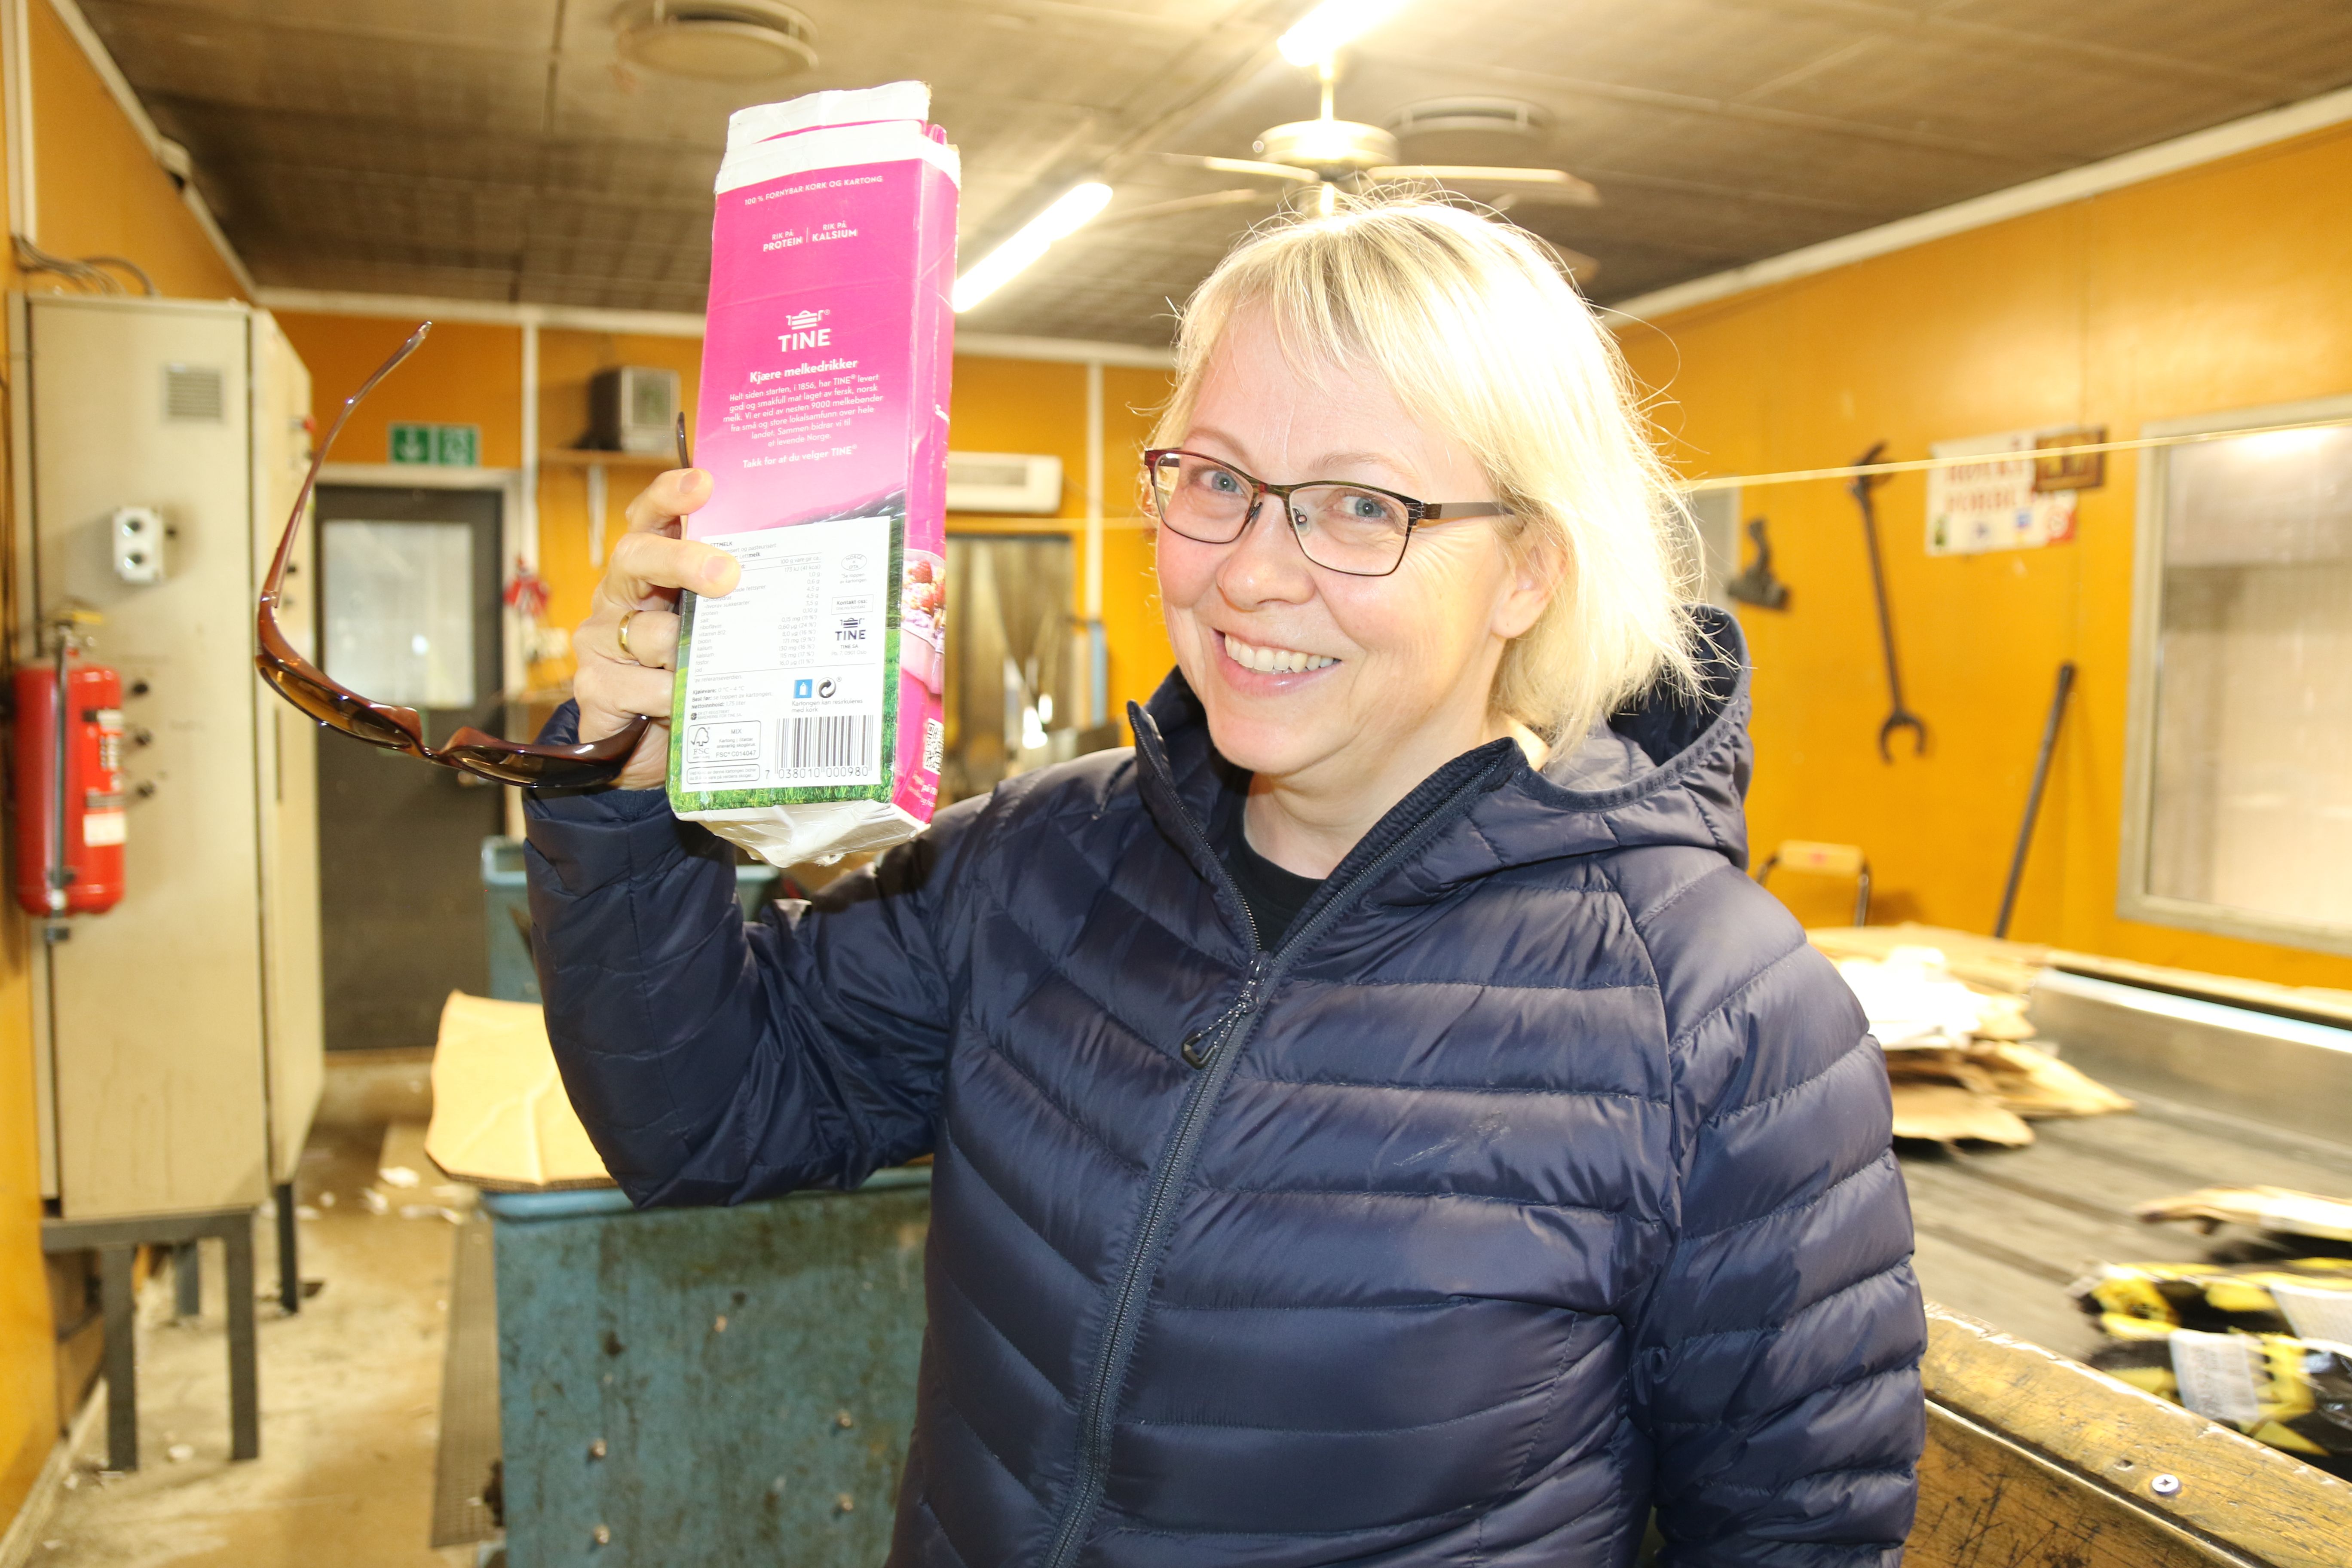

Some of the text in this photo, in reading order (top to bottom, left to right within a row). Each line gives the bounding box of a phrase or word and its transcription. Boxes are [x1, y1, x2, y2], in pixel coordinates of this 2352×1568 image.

[766, 186, 803, 200] FORNYBAR
[805, 182, 826, 191] KORK
[844, 175, 883, 185] KARTONG
[785, 229, 793, 237] PÅ
[837, 220, 846, 229] PÅ
[763, 236, 802, 251] PROTEIN
[812, 229, 857, 242] KALSIUM
[778, 328, 831, 352] TINE
[750, 358, 858, 384] Kjære melkedrikker
[744, 391, 764, 400] siden
[765, 386, 792, 396] starten,
[797, 383, 816, 391] 1856,
[818, 380, 831, 388] har
[857, 374, 879, 383] levert
[729, 405, 744, 414] god
[745, 402, 755, 410] og
[757, 397, 786, 408] smakfull
[803, 391, 822, 402] laget
[833, 386, 854, 396] fersk,
[856, 384, 878, 394] norsk
[723, 414, 743, 423] melk.
[763, 409, 774, 417] eid
[785, 404, 809, 413] nesten
[811, 401, 831, 409] 9000
[832, 395, 883, 407] melkebønder
[730, 424, 741, 432] fra
[741, 422, 756, 431] små
[758, 420, 768, 429] og
[770, 418, 787, 427] store
[788, 410, 838, 424] lokalsamfunn
[857, 406, 874, 414] hele
[751, 430, 775, 439] landet.
[777, 425, 809, 435] Sammen
[811, 421, 833, 431] bidrar
[776, 435, 806, 446] levende
[807, 432, 832, 443] Norge.
[742, 459, 762, 469] Takk
[763, 456, 776, 466] for
[801, 450, 828, 461] velger
[835, 630, 866, 640] TINE
[765, 766, 868, 779] 7 038010 000980
